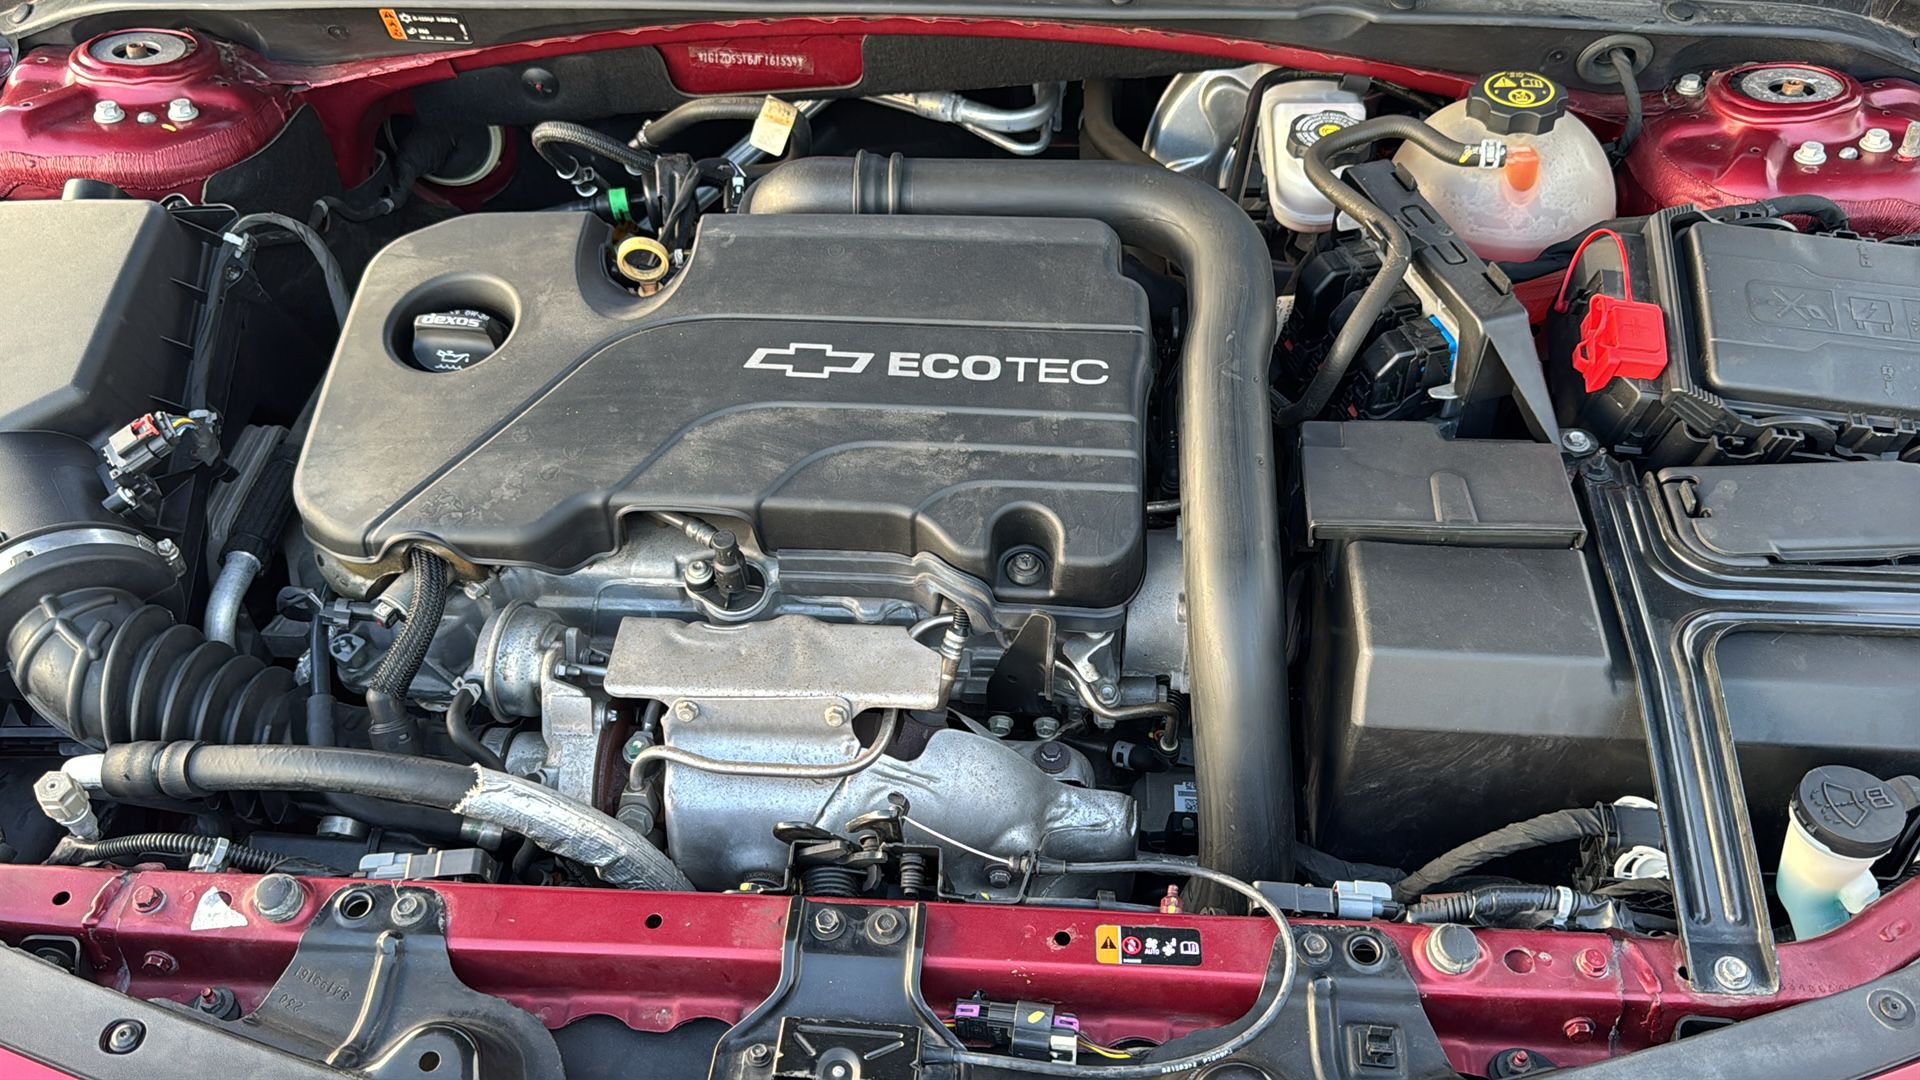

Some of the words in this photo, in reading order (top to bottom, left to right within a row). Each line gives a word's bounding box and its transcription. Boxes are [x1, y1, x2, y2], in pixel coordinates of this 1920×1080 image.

[421, 313, 482, 327] dexos
[888, 351, 1109, 385] ECOTEC
[1144, 948, 1160, 956] AUTO
